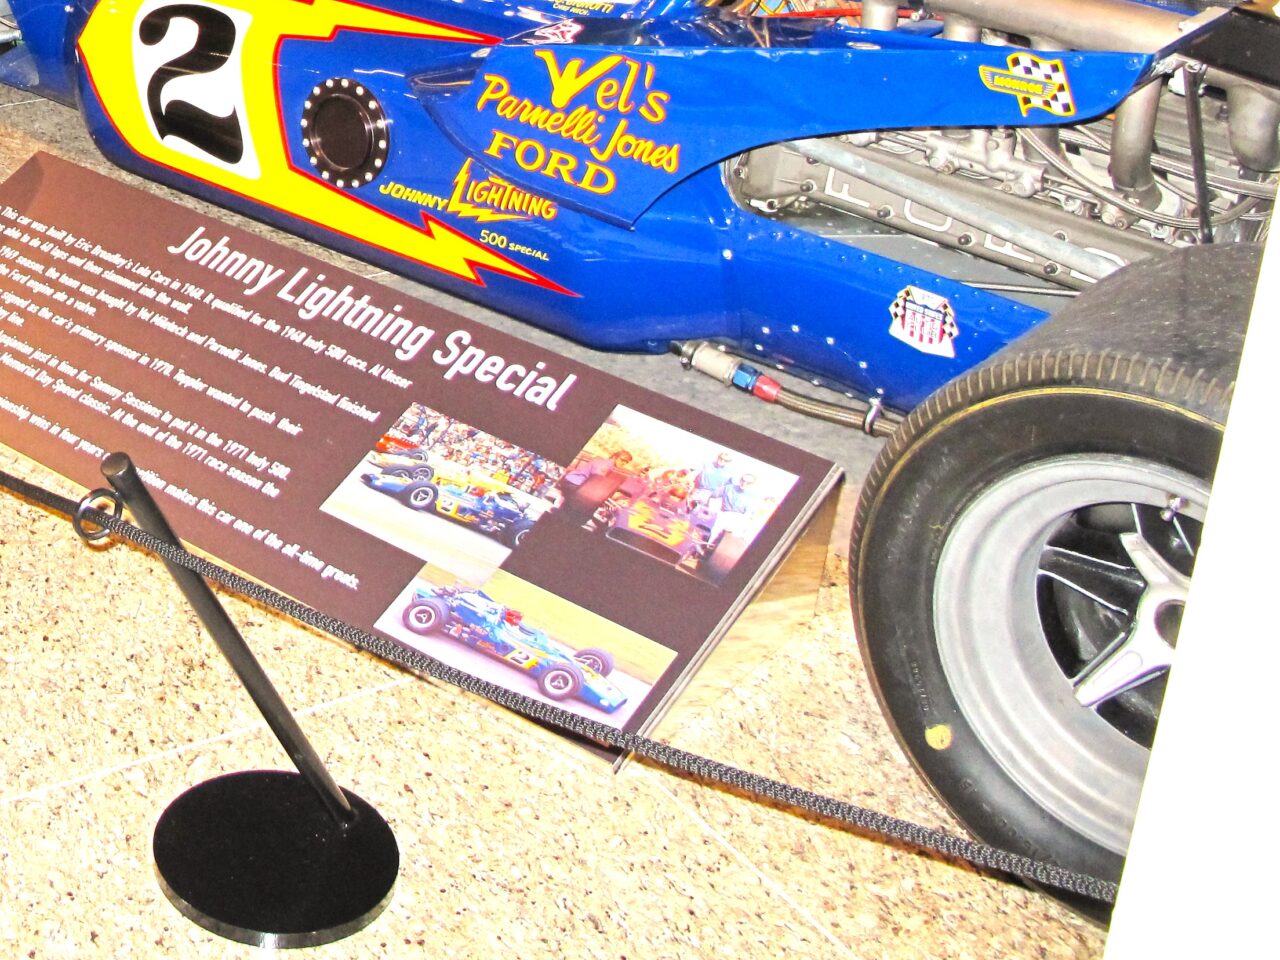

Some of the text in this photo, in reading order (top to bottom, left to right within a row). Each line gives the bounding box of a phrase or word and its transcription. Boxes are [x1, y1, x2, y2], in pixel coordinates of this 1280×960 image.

[138, 3, 244, 165] 2
[475, 73, 607, 145] Parnelli
[534, 48, 670, 124] Vel's
[483, 129, 618, 195] FORD
[589, 119, 681, 174] Jones
[378, 157, 558, 223] JOHNNY LIGHTNING
[4, 228, 22, 239] able
[21, 234, 30, 243] to
[29, 238, 41, 247] do
[51, 246, 69, 260] laps
[67, 256, 87, 267] and
[83, 261, 103, 275] then
[102, 271, 143, 291] slammed
[139, 287, 157, 298] into
[156, 292, 171, 305] the
[479, 228, 551, 261] 500 SPECIAL
[2, 207, 18, 220] This
[17, 216, 32, 225] car
[31, 221, 48, 232] was
[46, 227, 67, 240] built
[64, 234, 77, 246] by
[74, 238, 92, 252] Eric
[150, 271, 171, 286] Cars
[170, 279, 181, 290] in
[204, 293, 214, 304] It
[212, 299, 253, 320] qualified
[250, 313, 266, 326] for
[264, 320, 281, 333] the
[281, 326, 306, 343] 1968
[303, 336, 327, 353] Indy
[325, 345, 347, 360] 500
[369, 364, 384, 376] Al
[381, 369, 413, 388] Unser
[8, 269, 31, 284] Ford
[27, 280, 54, 296] engine
[53, 292, 68, 302] ate
[167, 226, 578, 413] Johnny Lightning Special
[1, 292, 31, 308] signed
[27, 304, 39, 313] as
[38, 308, 53, 319] the
[70, 325, 107, 346] primary
[105, 340, 141, 360] sponsor
[138, 354, 150, 365] in
[207, 387, 243, 408] wanted
[240, 401, 251, 412] to
[248, 408, 276, 424] push
[277, 418, 303, 435] their
[45, 268, 60, 279] the
[59, 274, 81, 289] team
[80, 284, 98, 296] was
[96, 290, 128, 310] bought
[125, 303, 138, 316] by
[186, 333, 208, 345] and
[269, 367, 292, 382] Bud
[337, 397, 380, 422] finished
